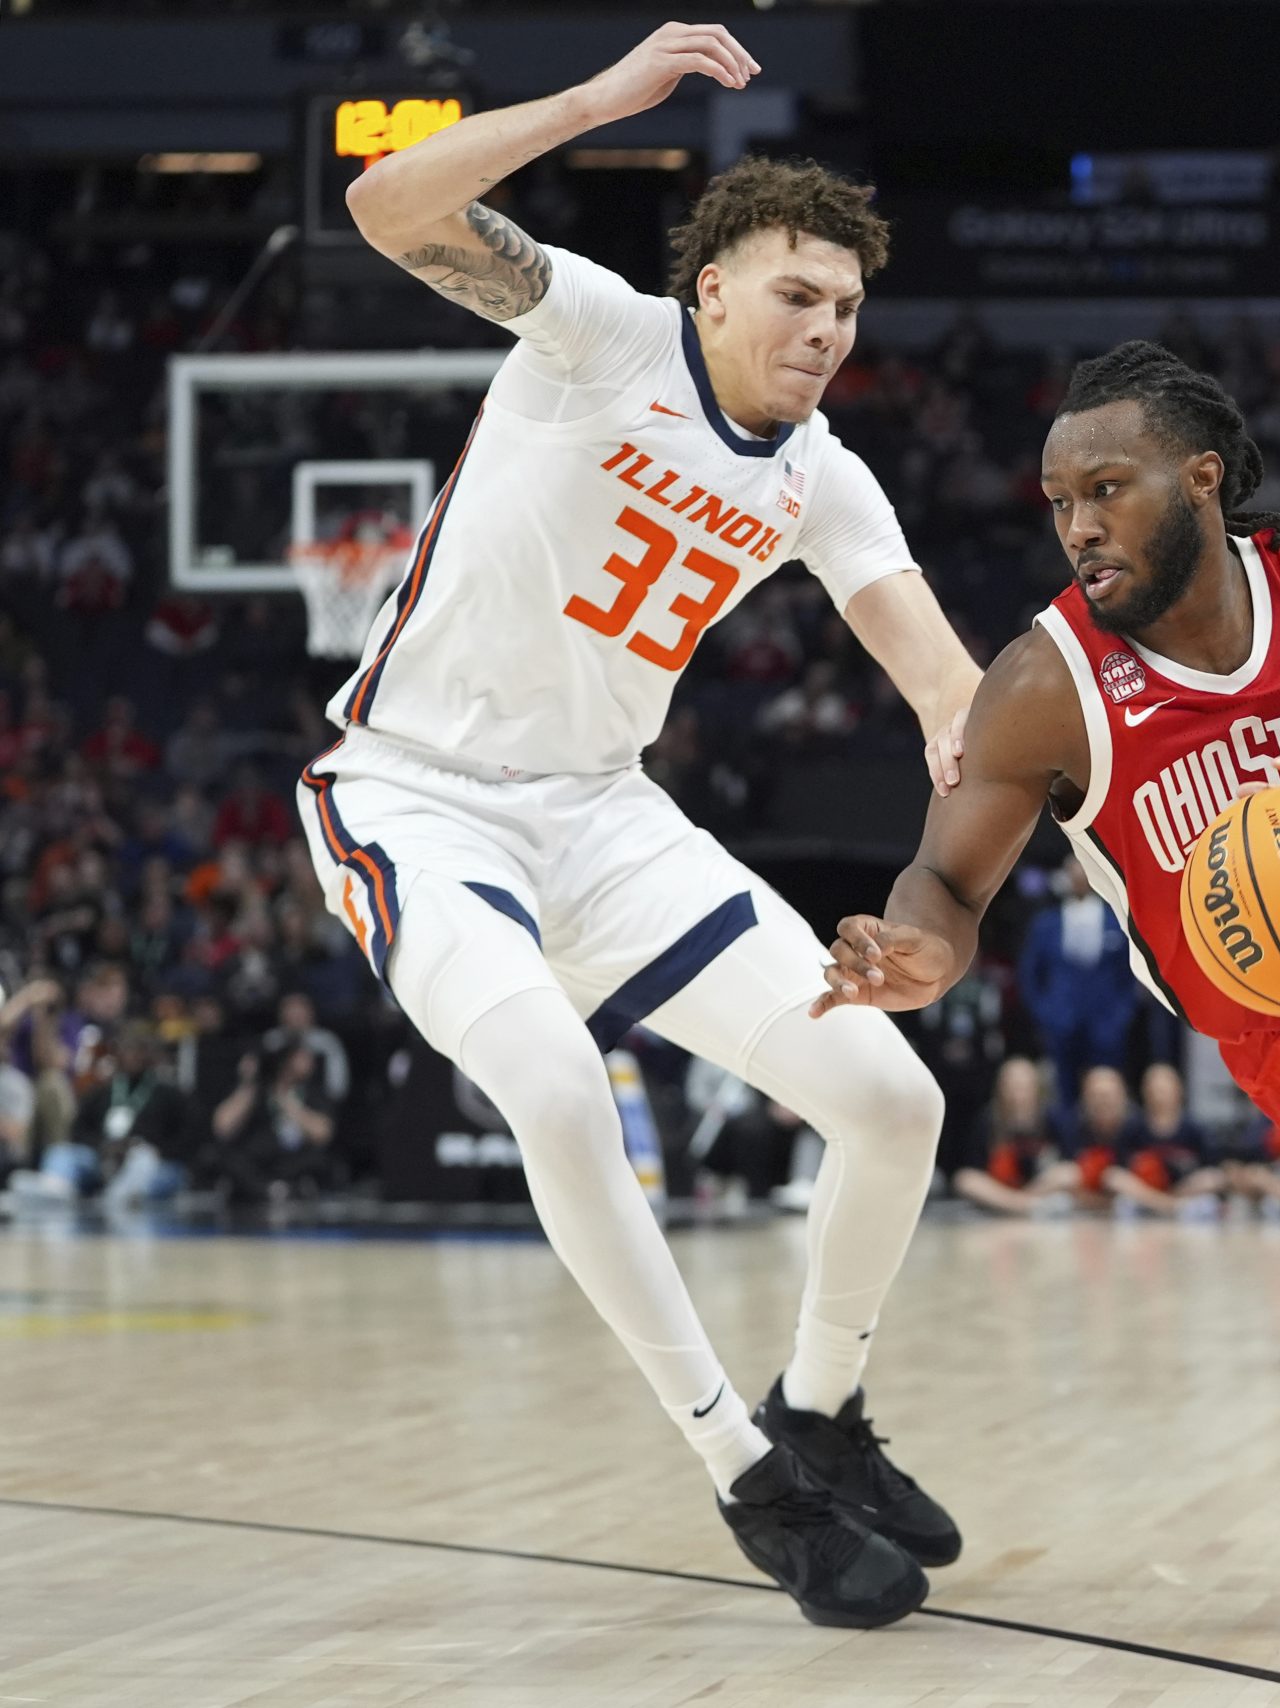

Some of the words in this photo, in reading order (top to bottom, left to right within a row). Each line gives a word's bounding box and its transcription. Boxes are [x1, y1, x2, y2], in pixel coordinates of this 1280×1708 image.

[600, 442, 782, 562] ILLINOIS
[563, 506, 740, 671] 33
[1205, 815, 1263, 973] Wilson
